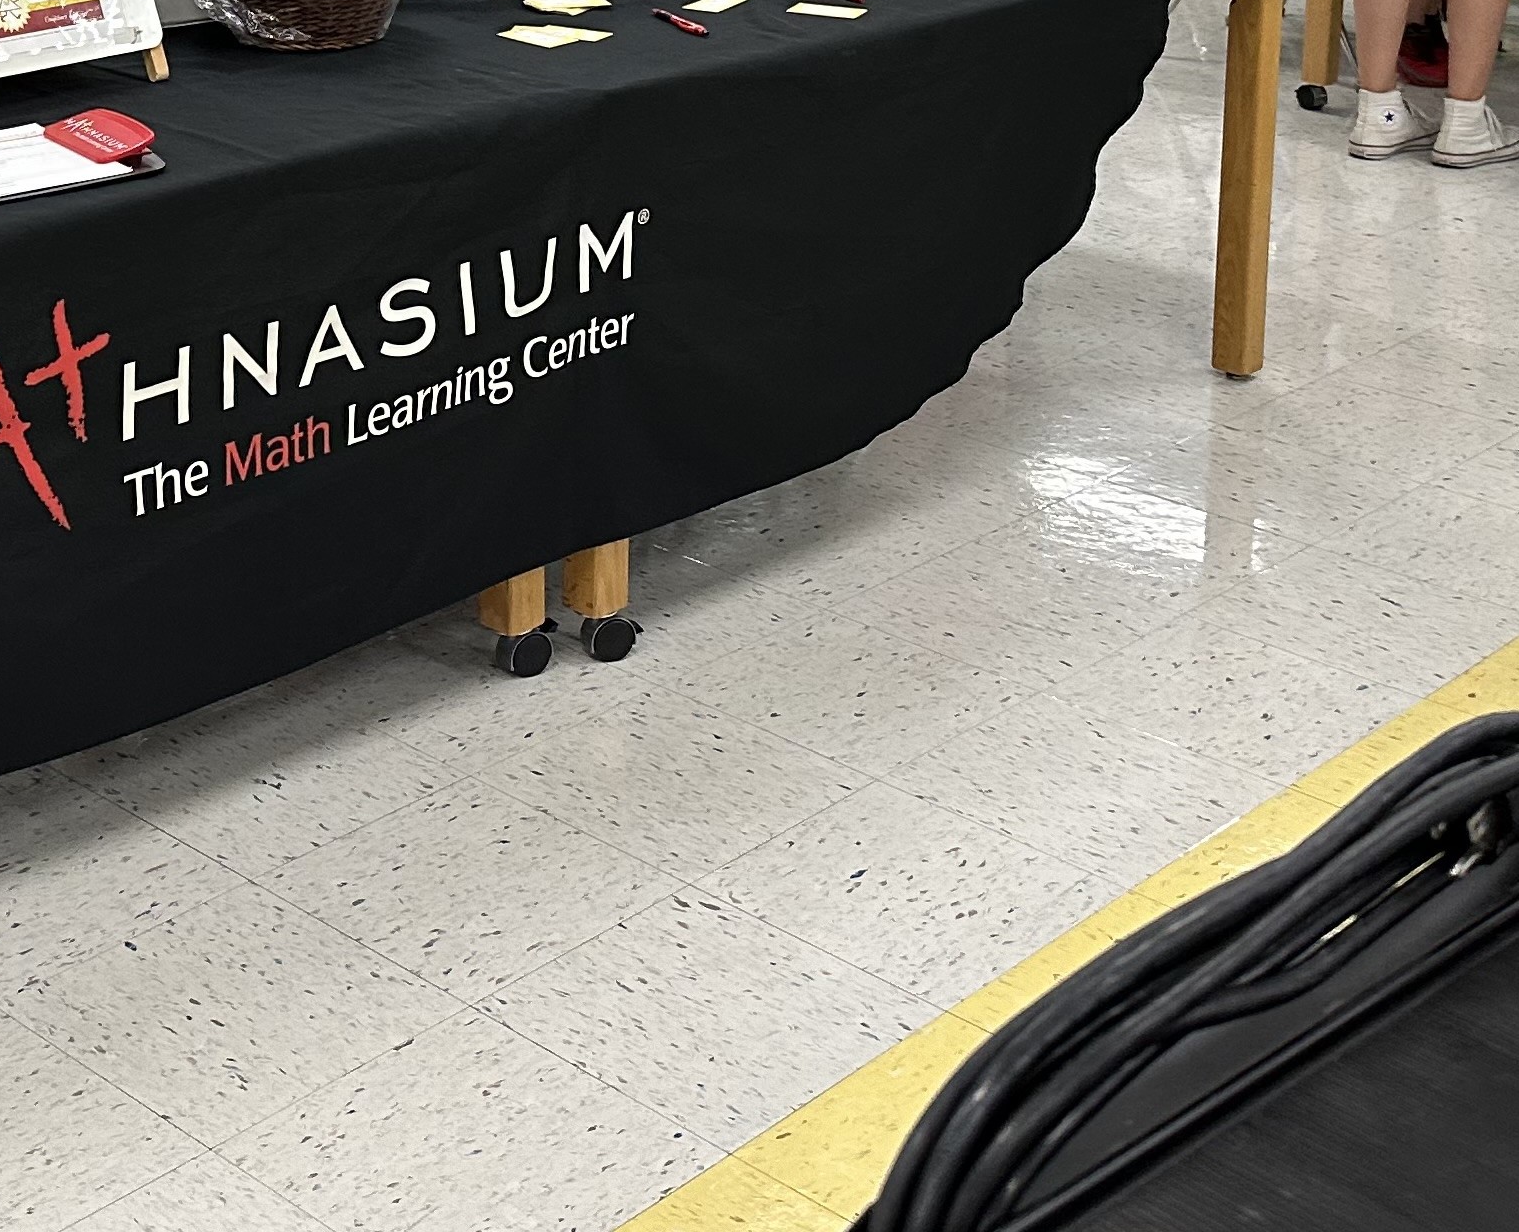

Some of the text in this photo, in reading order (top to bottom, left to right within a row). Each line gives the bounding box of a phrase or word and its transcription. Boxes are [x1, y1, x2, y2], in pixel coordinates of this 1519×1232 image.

[124, 310, 635, 516] The Math Learning Center
